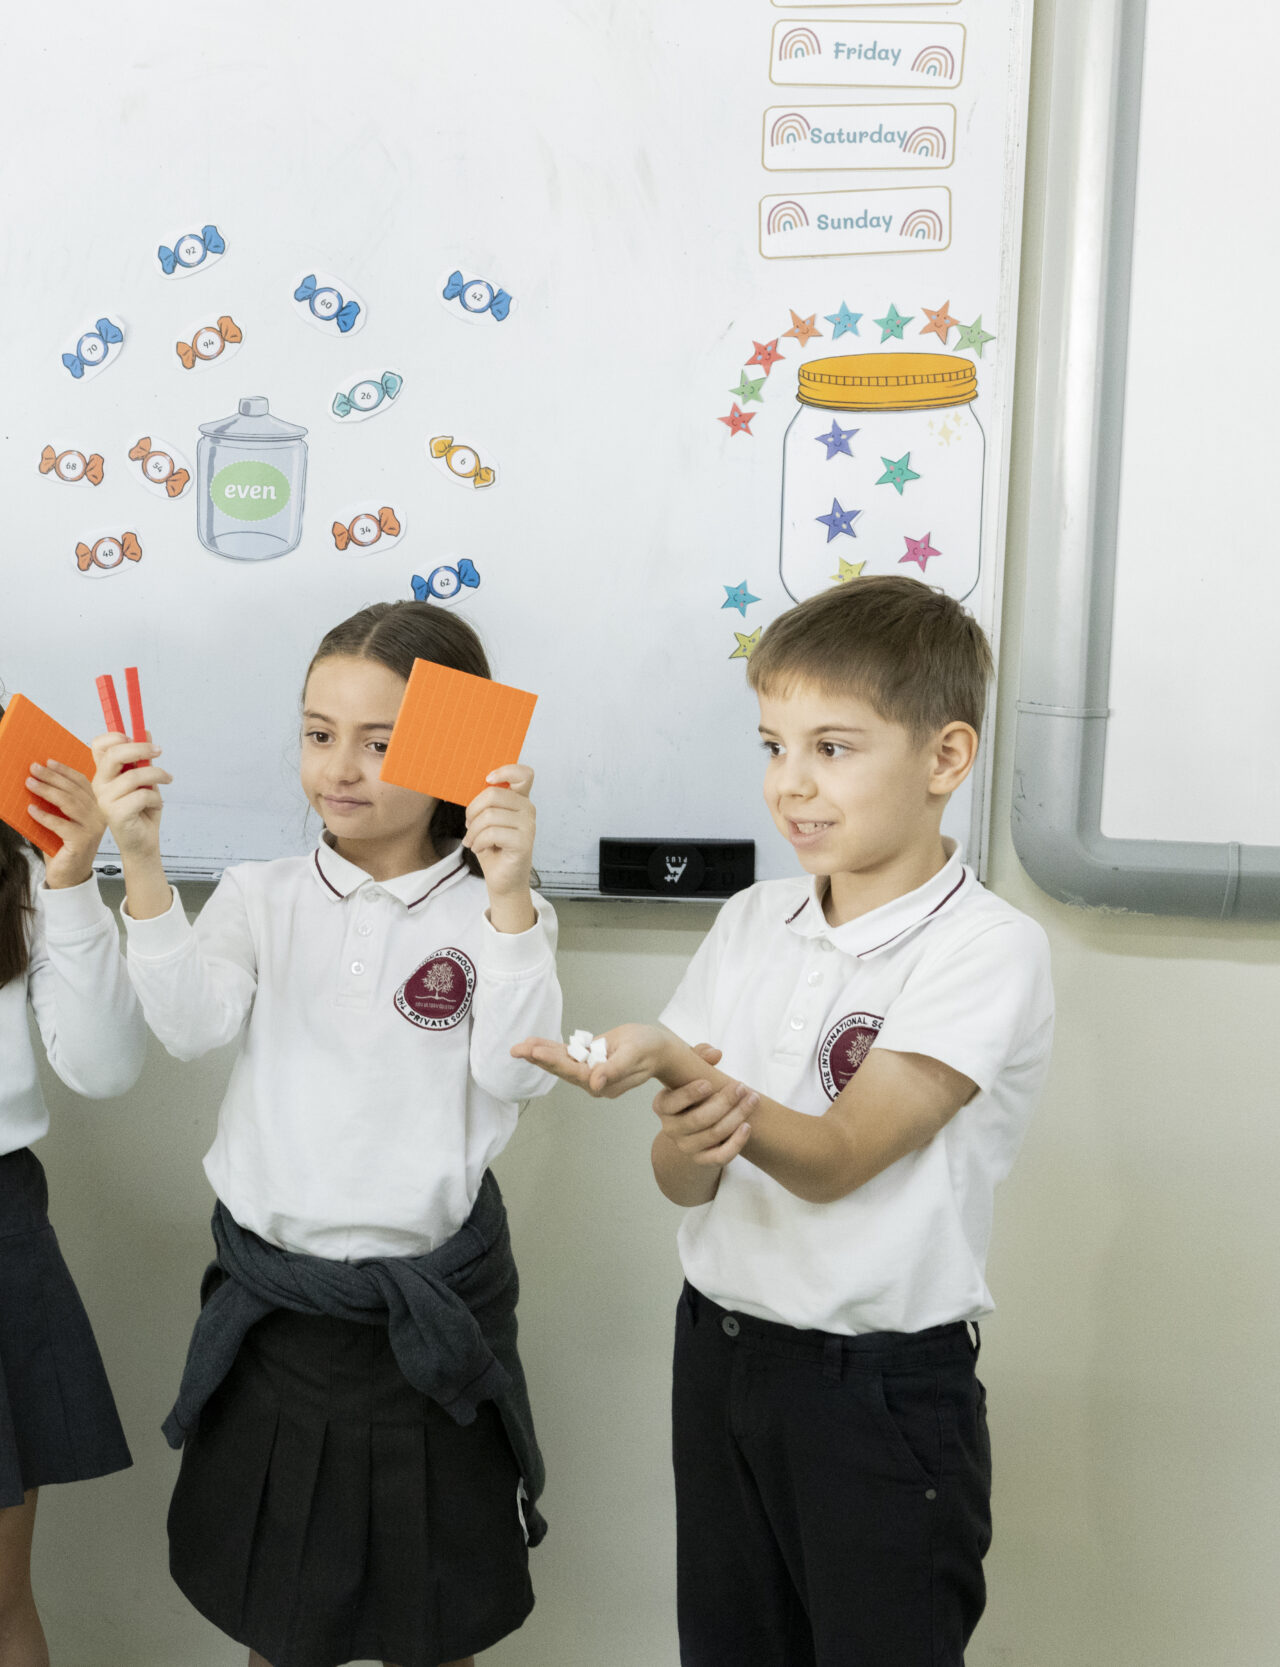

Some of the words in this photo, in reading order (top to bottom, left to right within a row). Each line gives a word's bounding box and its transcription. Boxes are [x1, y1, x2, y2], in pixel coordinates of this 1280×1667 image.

[833, 40, 902, 66] Friday
[810, 123, 908, 149] Saturday
[817, 209, 893, 233] Sunday
[185, 246, 197, 256] 92
[471, 291, 484, 302] 42
[320, 298, 333, 310] 60
[86, 343, 98, 355] 70
[202, 338, 215, 349] 94
[360, 391, 372, 400] 26
[65, 461, 77, 471] 68
[459, 457, 467, 466] 6
[224, 483, 277, 500] even
[359, 525, 372, 536] 34
[102, 548, 114, 558] 48
[439, 577, 451, 588] 62
[446, 950, 472, 977] SCHOOL
[408, 1010, 450, 1027] PRIVATE
[822, 1016, 868, 1068] INTERNATIONAL
[824, 1071, 833, 1091] THE
